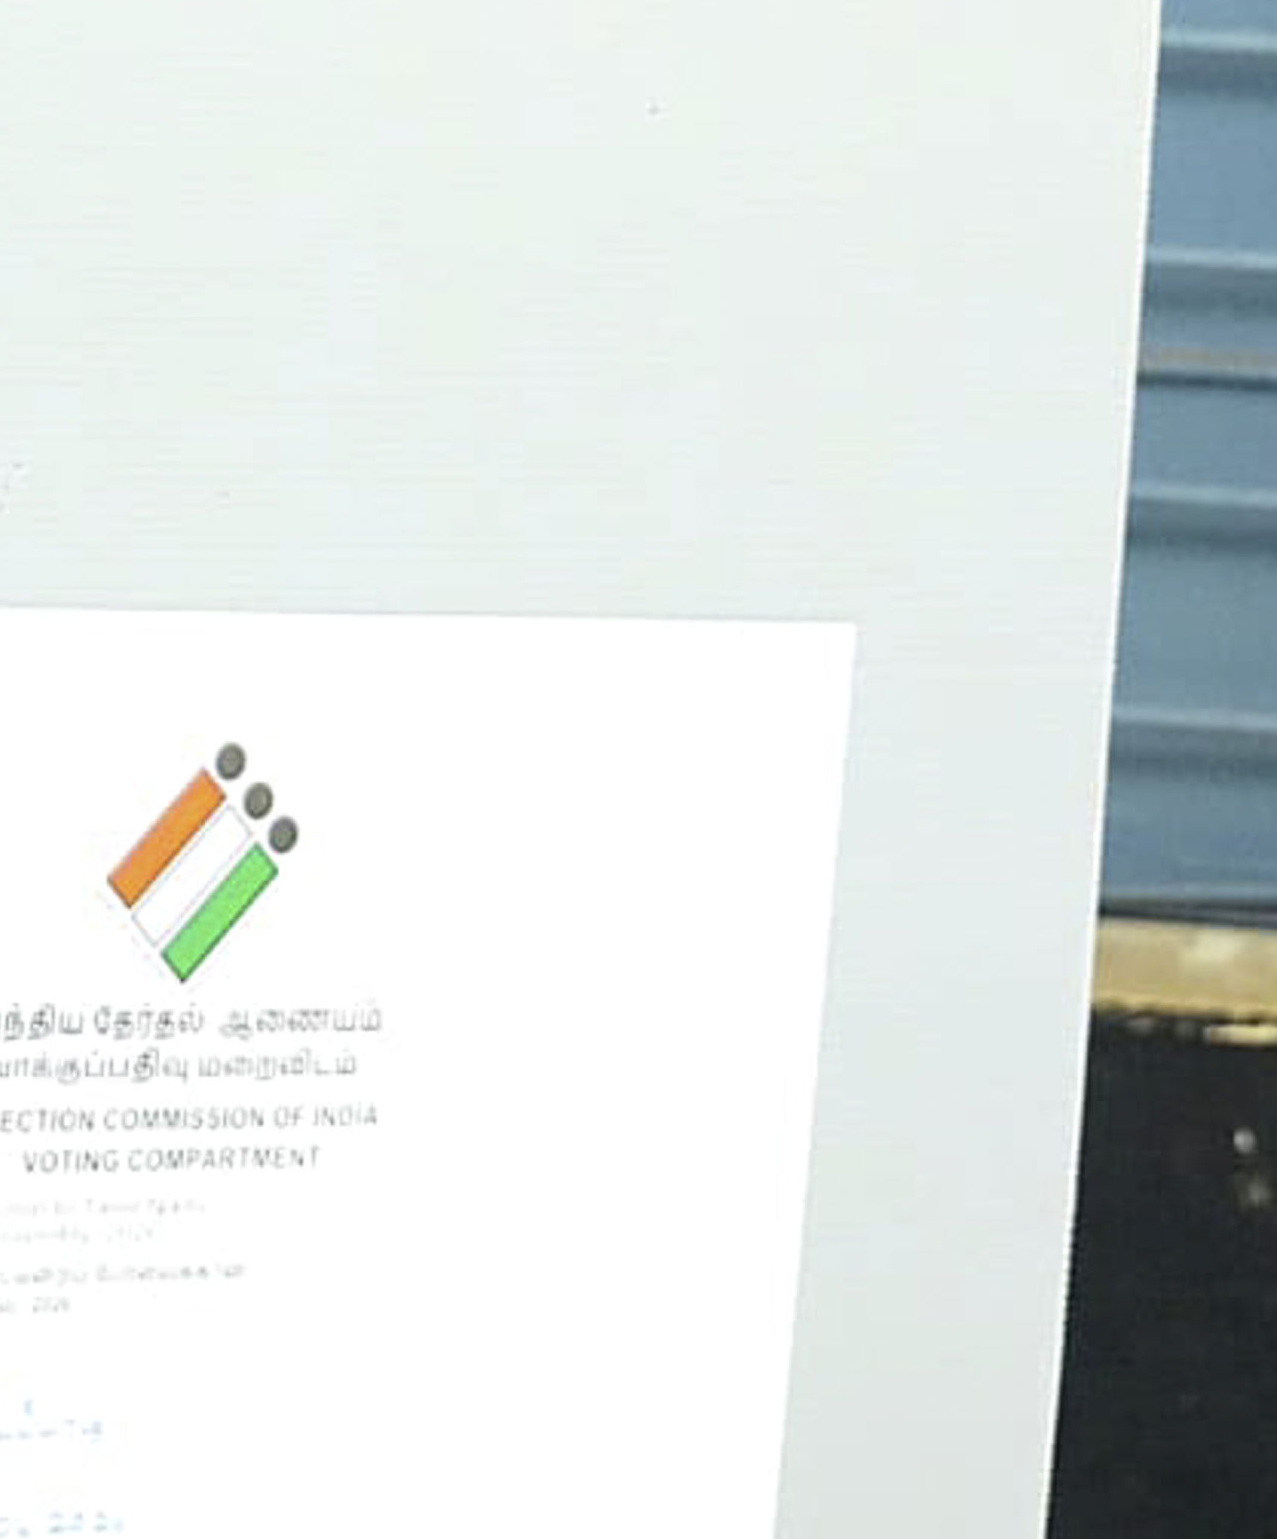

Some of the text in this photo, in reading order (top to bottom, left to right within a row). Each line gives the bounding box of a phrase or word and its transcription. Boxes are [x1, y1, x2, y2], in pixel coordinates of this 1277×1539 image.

[93, 1003, 204, 1040] தேர்தல்
[219, 1008, 381, 1041] ஆணையம்
[103, 1107, 264, 1131] COMMISSION
[273, 1106, 302, 1129] OF
[313, 1106, 377, 1126] INDIA
[23, 1145, 319, 1173] VOTING COMPARTMENT
